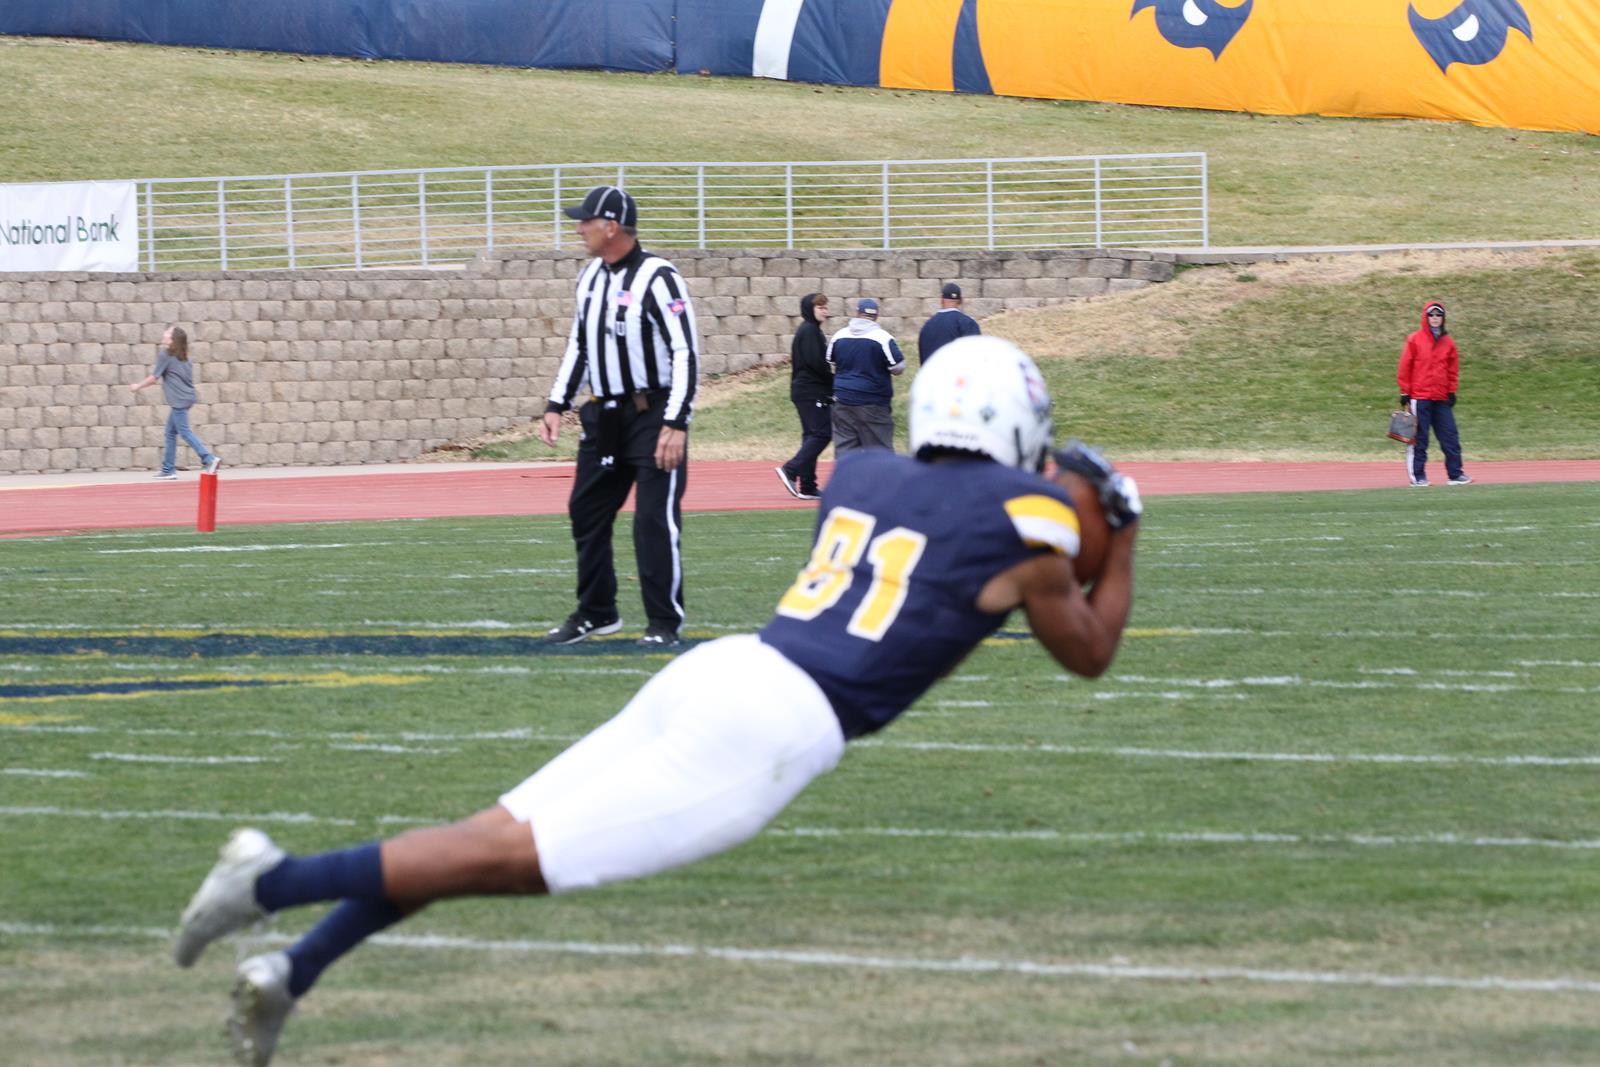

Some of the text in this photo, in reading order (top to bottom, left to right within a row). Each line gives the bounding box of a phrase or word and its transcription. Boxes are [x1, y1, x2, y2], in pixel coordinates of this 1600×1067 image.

[0, 213, 120, 245] National Bank
[775, 505, 928, 642] 81
